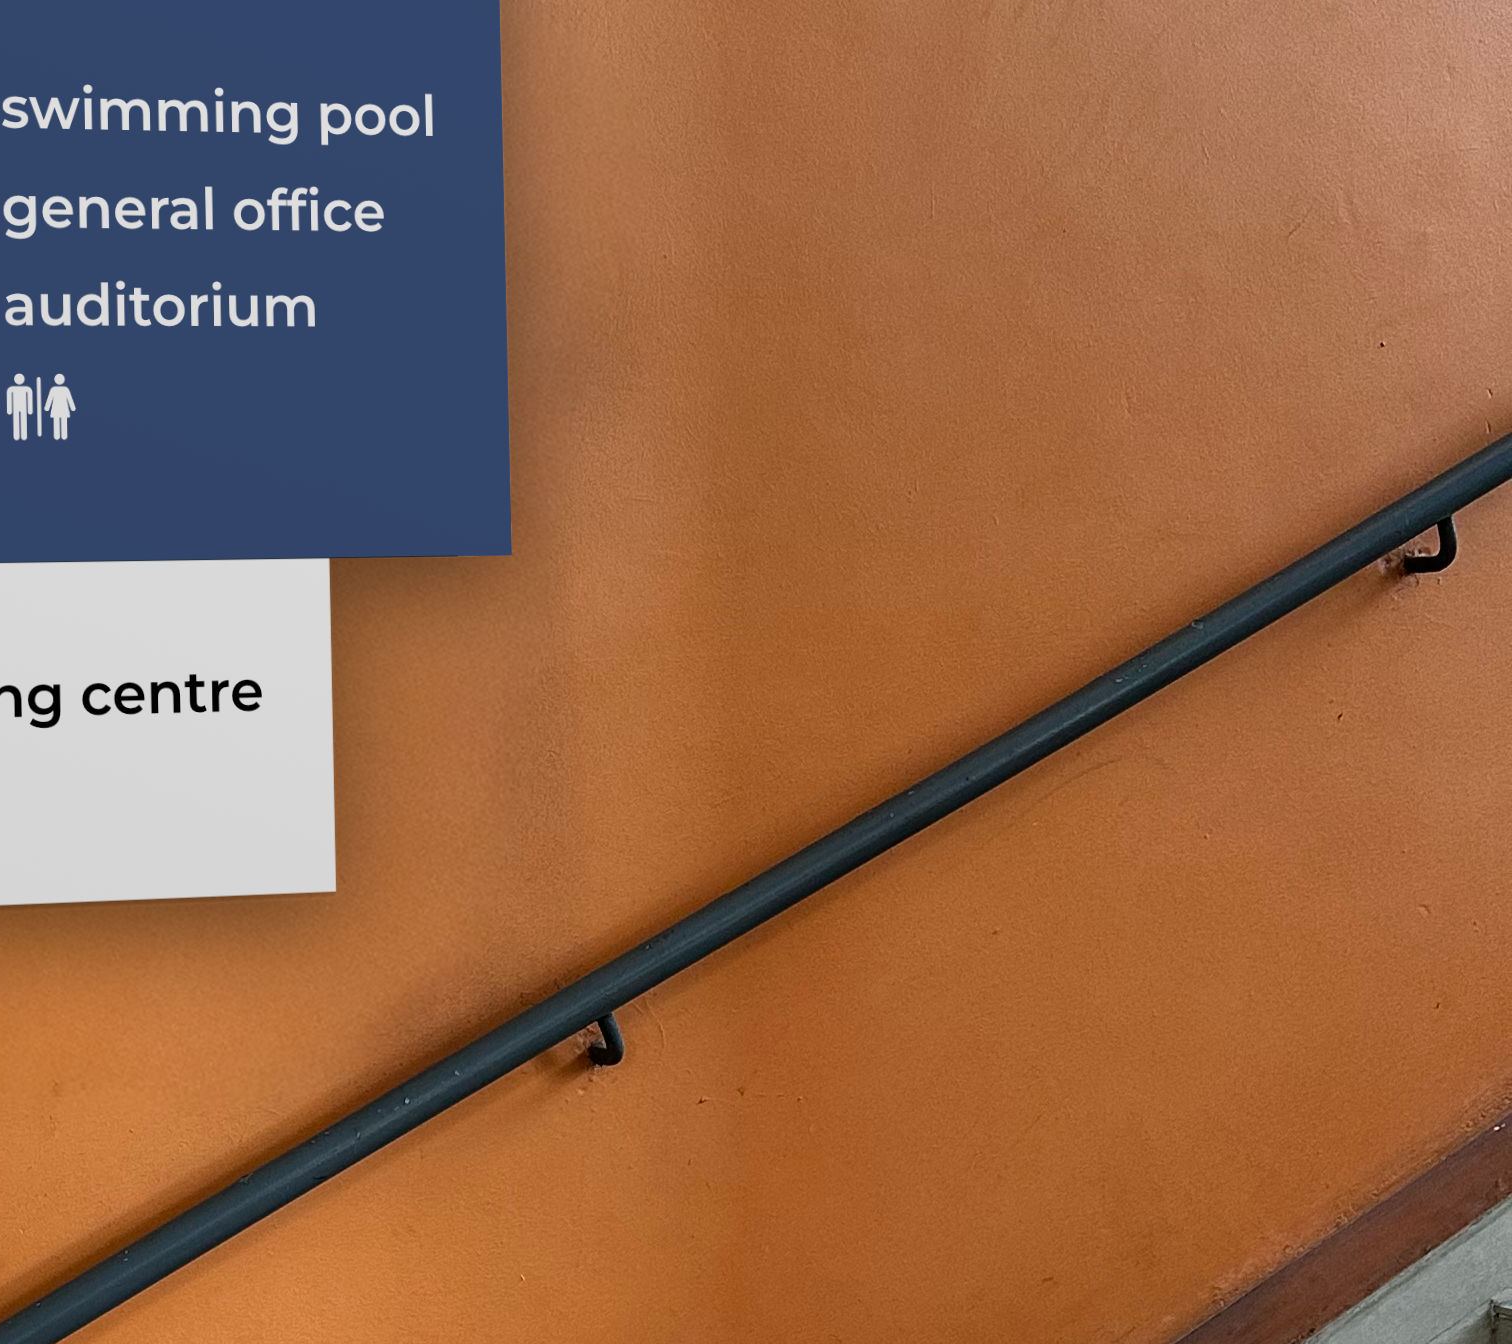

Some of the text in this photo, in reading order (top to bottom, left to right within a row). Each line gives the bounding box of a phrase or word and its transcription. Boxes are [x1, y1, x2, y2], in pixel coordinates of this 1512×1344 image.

[1, 84, 434, 146] swimming pool
[3, 186, 385, 240] general office
[4, 280, 316, 328] auditorium
[81, 673, 263, 716] centre
